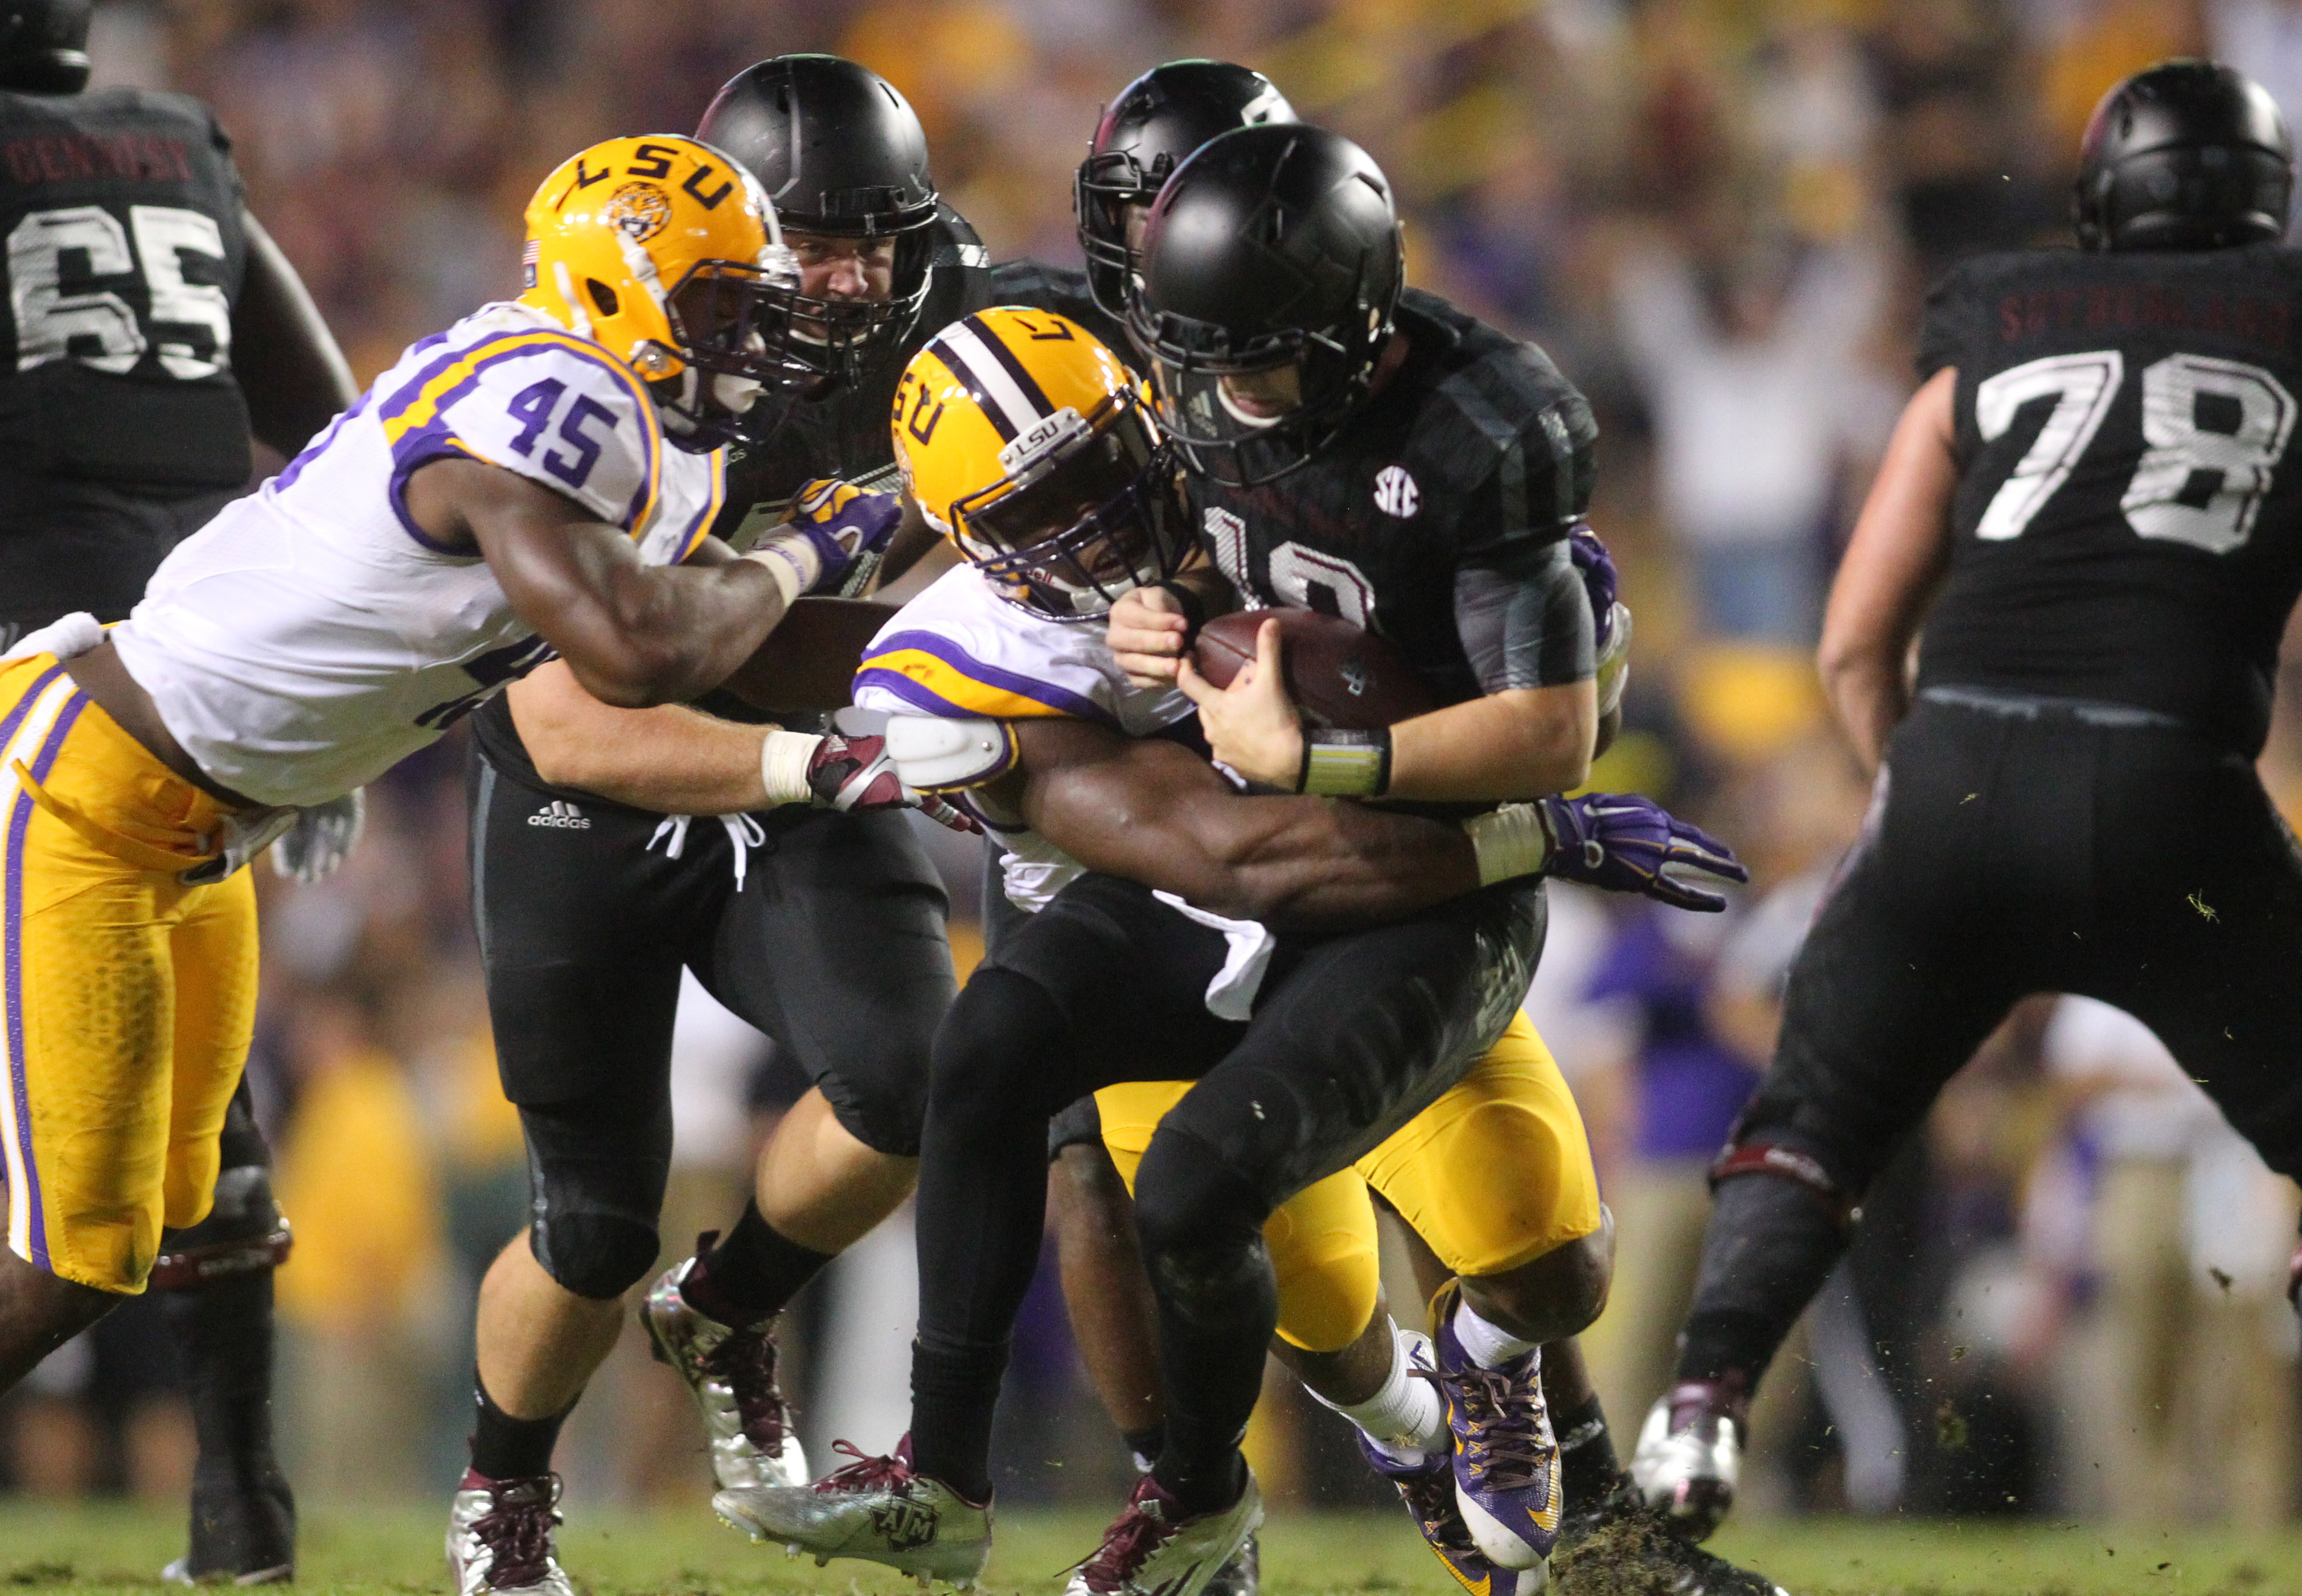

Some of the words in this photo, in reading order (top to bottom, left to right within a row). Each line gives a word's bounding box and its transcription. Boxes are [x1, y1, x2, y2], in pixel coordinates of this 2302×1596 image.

[577, 144, 733, 210] LSU
[6, 204, 231, 379] 65
[505, 376, 620, 490] 45
[1016, 422, 1058, 456] LSU
[1975, 350, 2299, 554] 78
[527, 814, 591, 829] adidas
